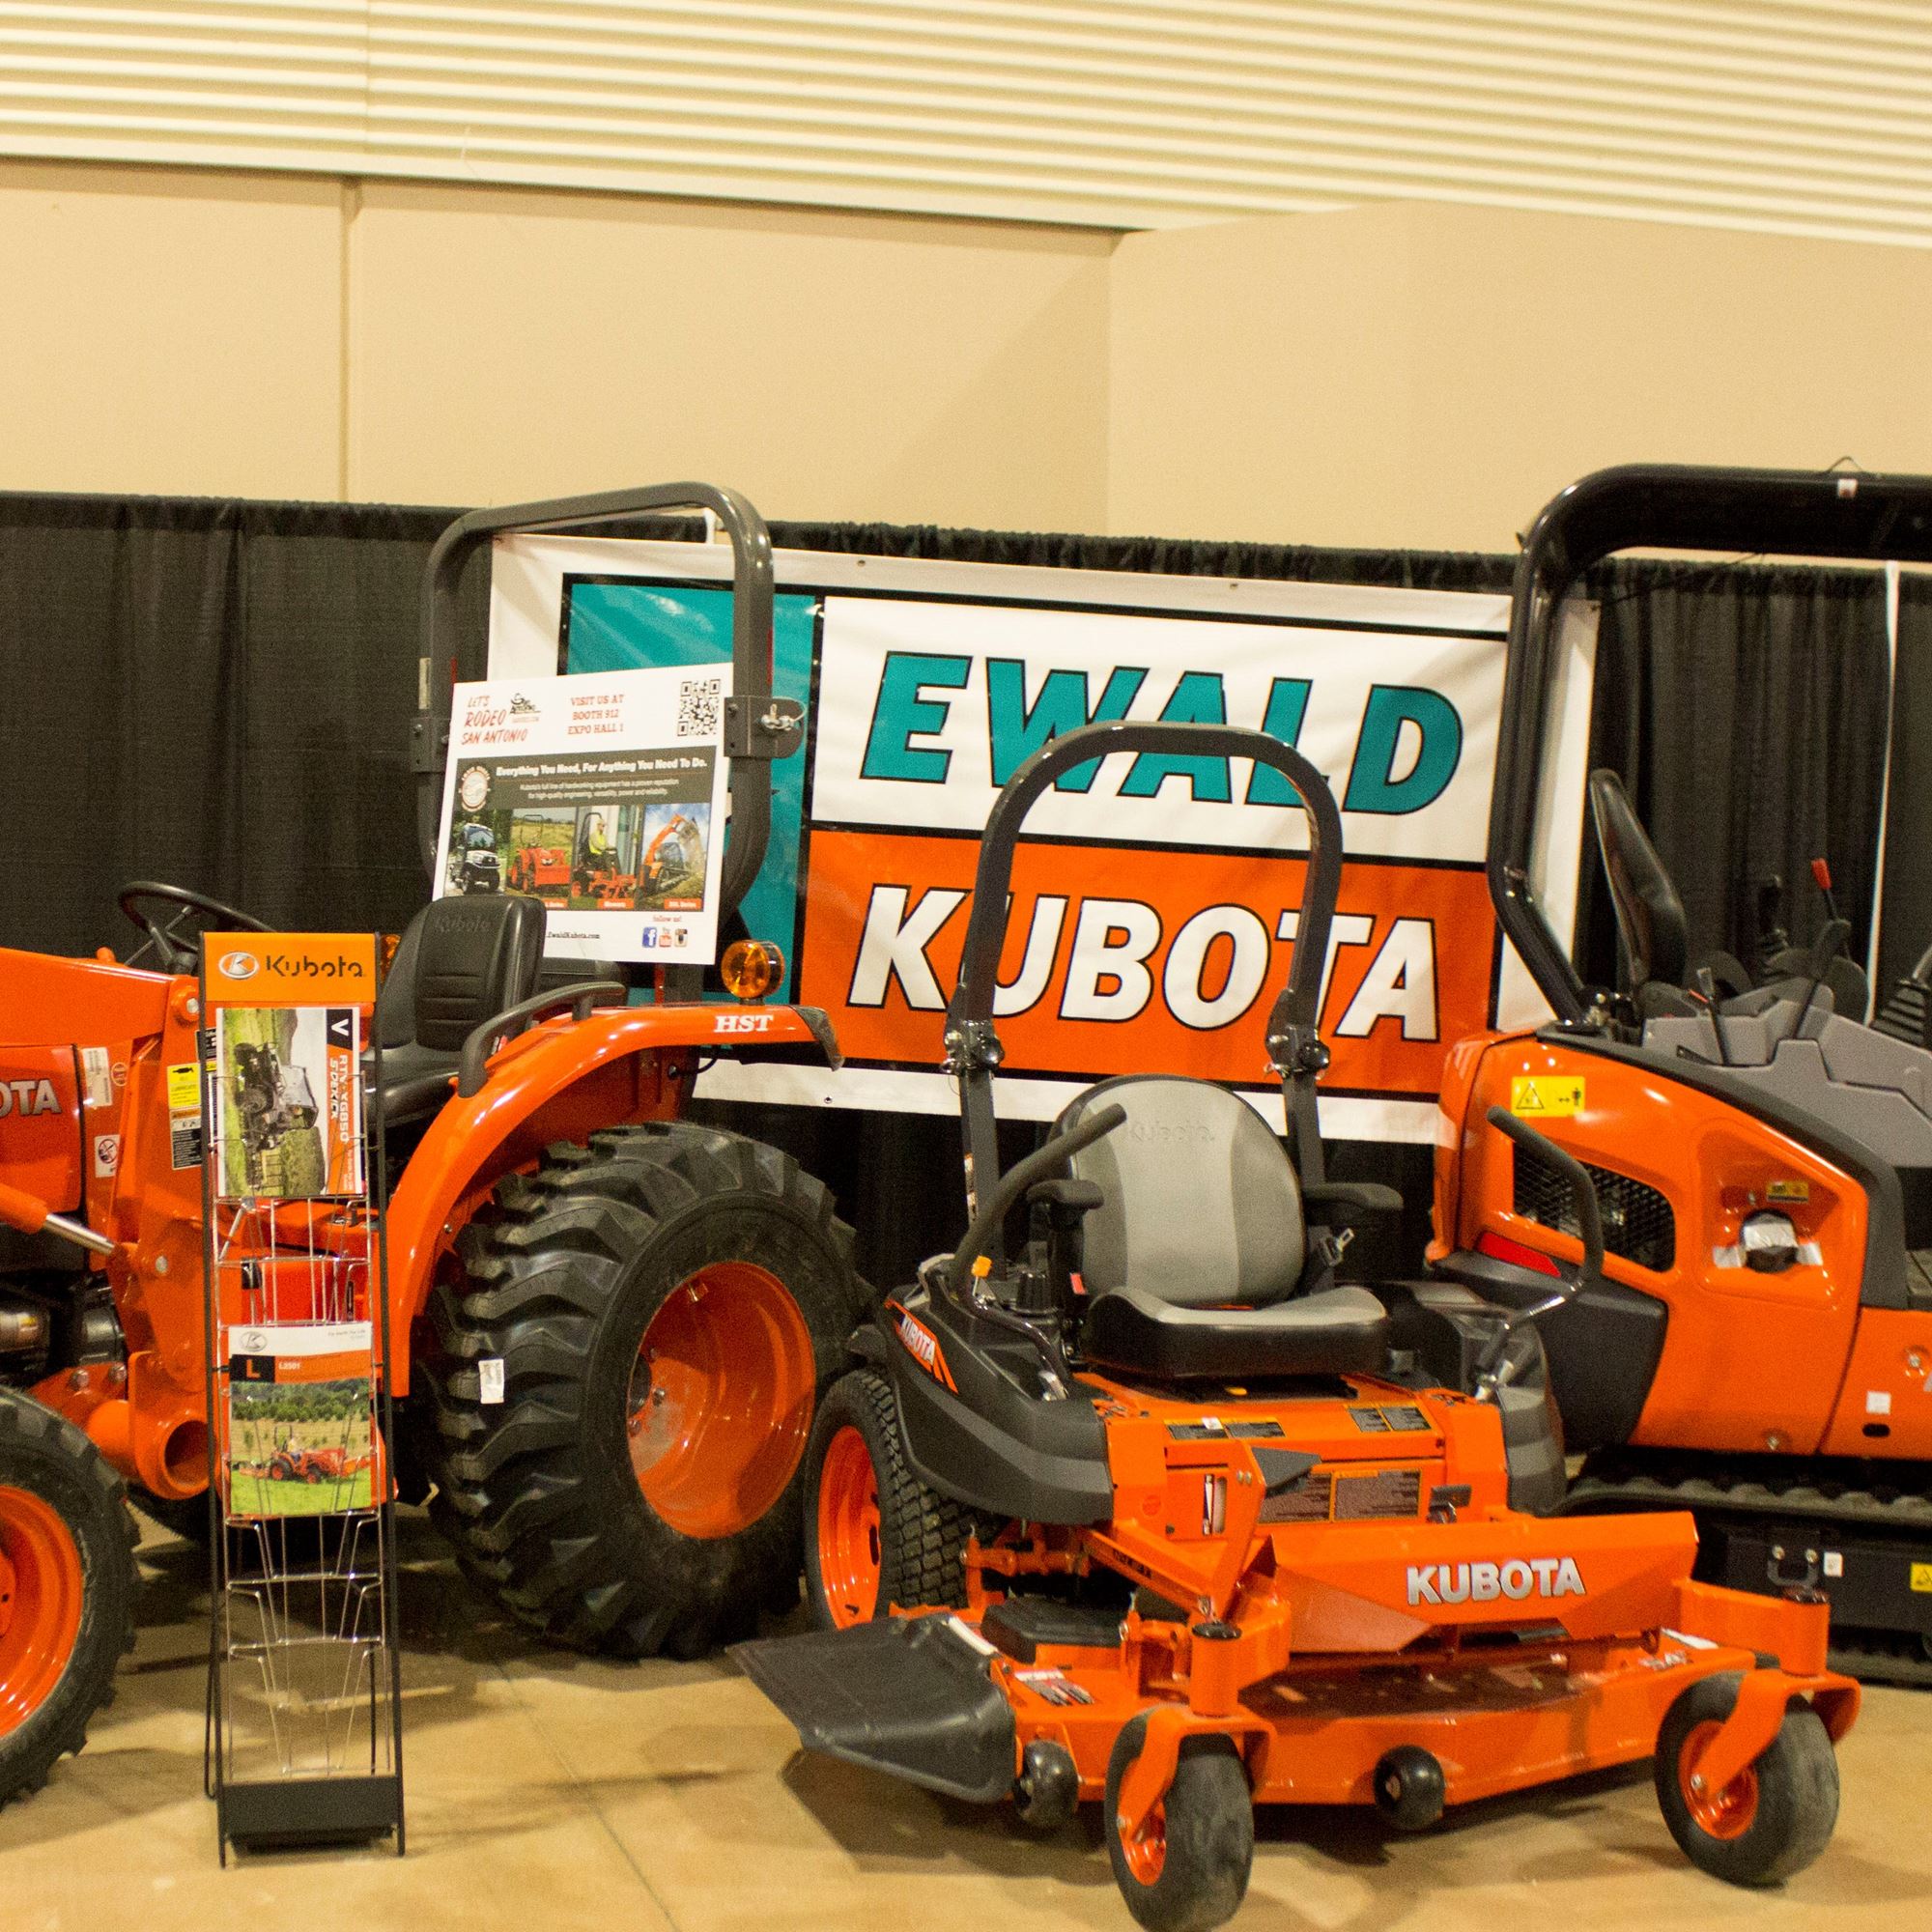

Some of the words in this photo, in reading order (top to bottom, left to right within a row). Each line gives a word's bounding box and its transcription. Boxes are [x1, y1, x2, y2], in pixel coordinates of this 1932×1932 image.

[468, 696, 490, 708] LET'S
[570, 696, 595, 706] VISIT
[596, 696, 609, 705] US
[611, 695, 624, 704] AT
[465, 709, 508, 726] RODEO
[572, 710, 603, 721] BOOTH
[461, 731, 480, 745] SAN
[483, 728, 528, 744] ANTONIO
[568, 724, 592, 735] EXPO
[593, 724, 617, 733] HALL
[859, 650, 1463, 814] EWALD
[496, 766, 539, 778] Everything
[540, 764, 556, 775] You
[598, 761, 637, 773] Anything
[638, 760, 654, 770] You
[655, 758, 678, 769] Need
[680, 757, 691, 768] To
[266, 954, 364, 978] Kubota
[846, 884, 1440, 1043] KUBOTA
[331, 1019, 349, 1036] V
[713, 1014, 773, 1033] HST
[900, 1314, 935, 1365] KUBOTA
[246, 1359, 261, 1378] L
[1406, 1556, 1586, 1607] KUBOTA
